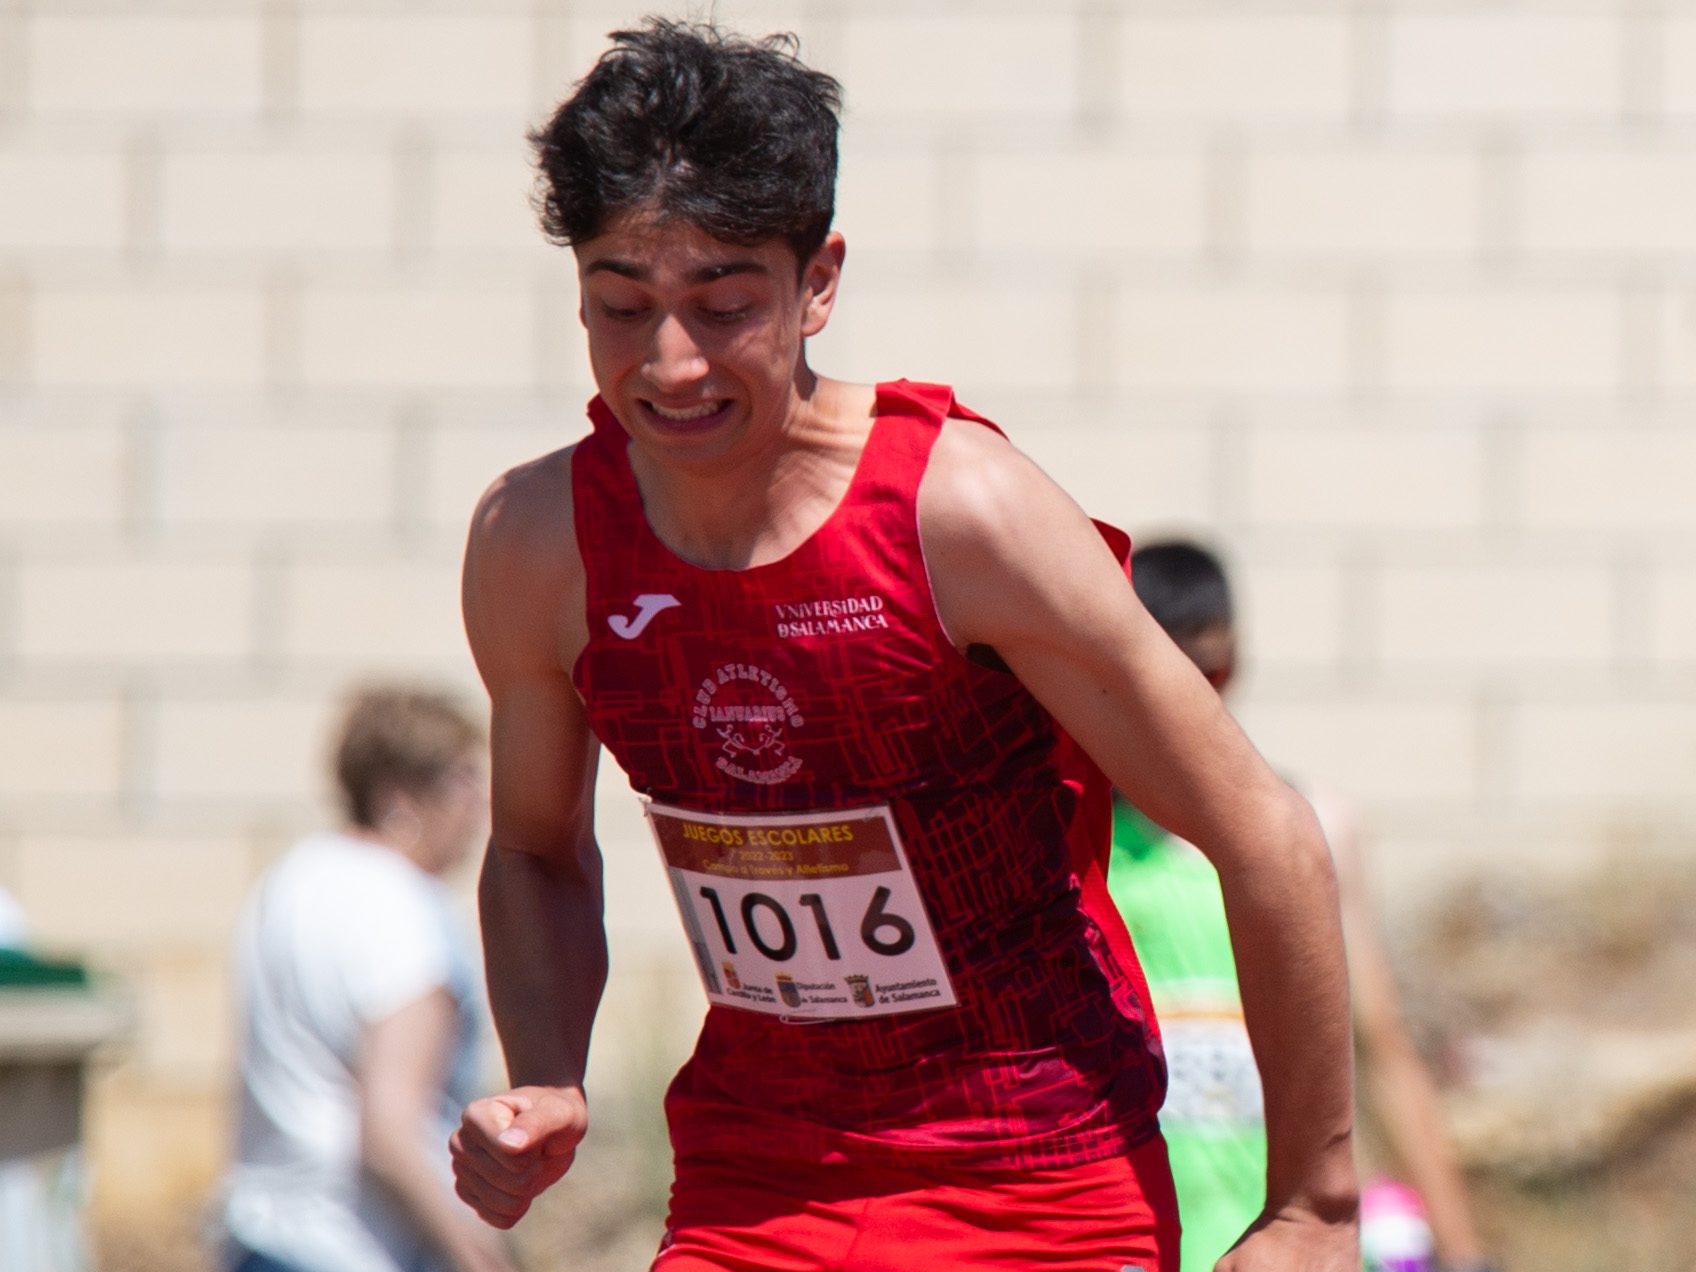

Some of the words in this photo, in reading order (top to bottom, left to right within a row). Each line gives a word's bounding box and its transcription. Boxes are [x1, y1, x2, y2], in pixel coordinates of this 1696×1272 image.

[716, 663, 804, 728] ATLETISMO
[682, 821, 743, 846] JUEGOS
[747, 825, 854, 846] ESCOLARES
[699, 885, 916, 962] 1016
[876, 978, 938, 994] Ayuntamiento
[879, 995, 891, 1004] de
[892, 989, 942, 1003] Salamanca
